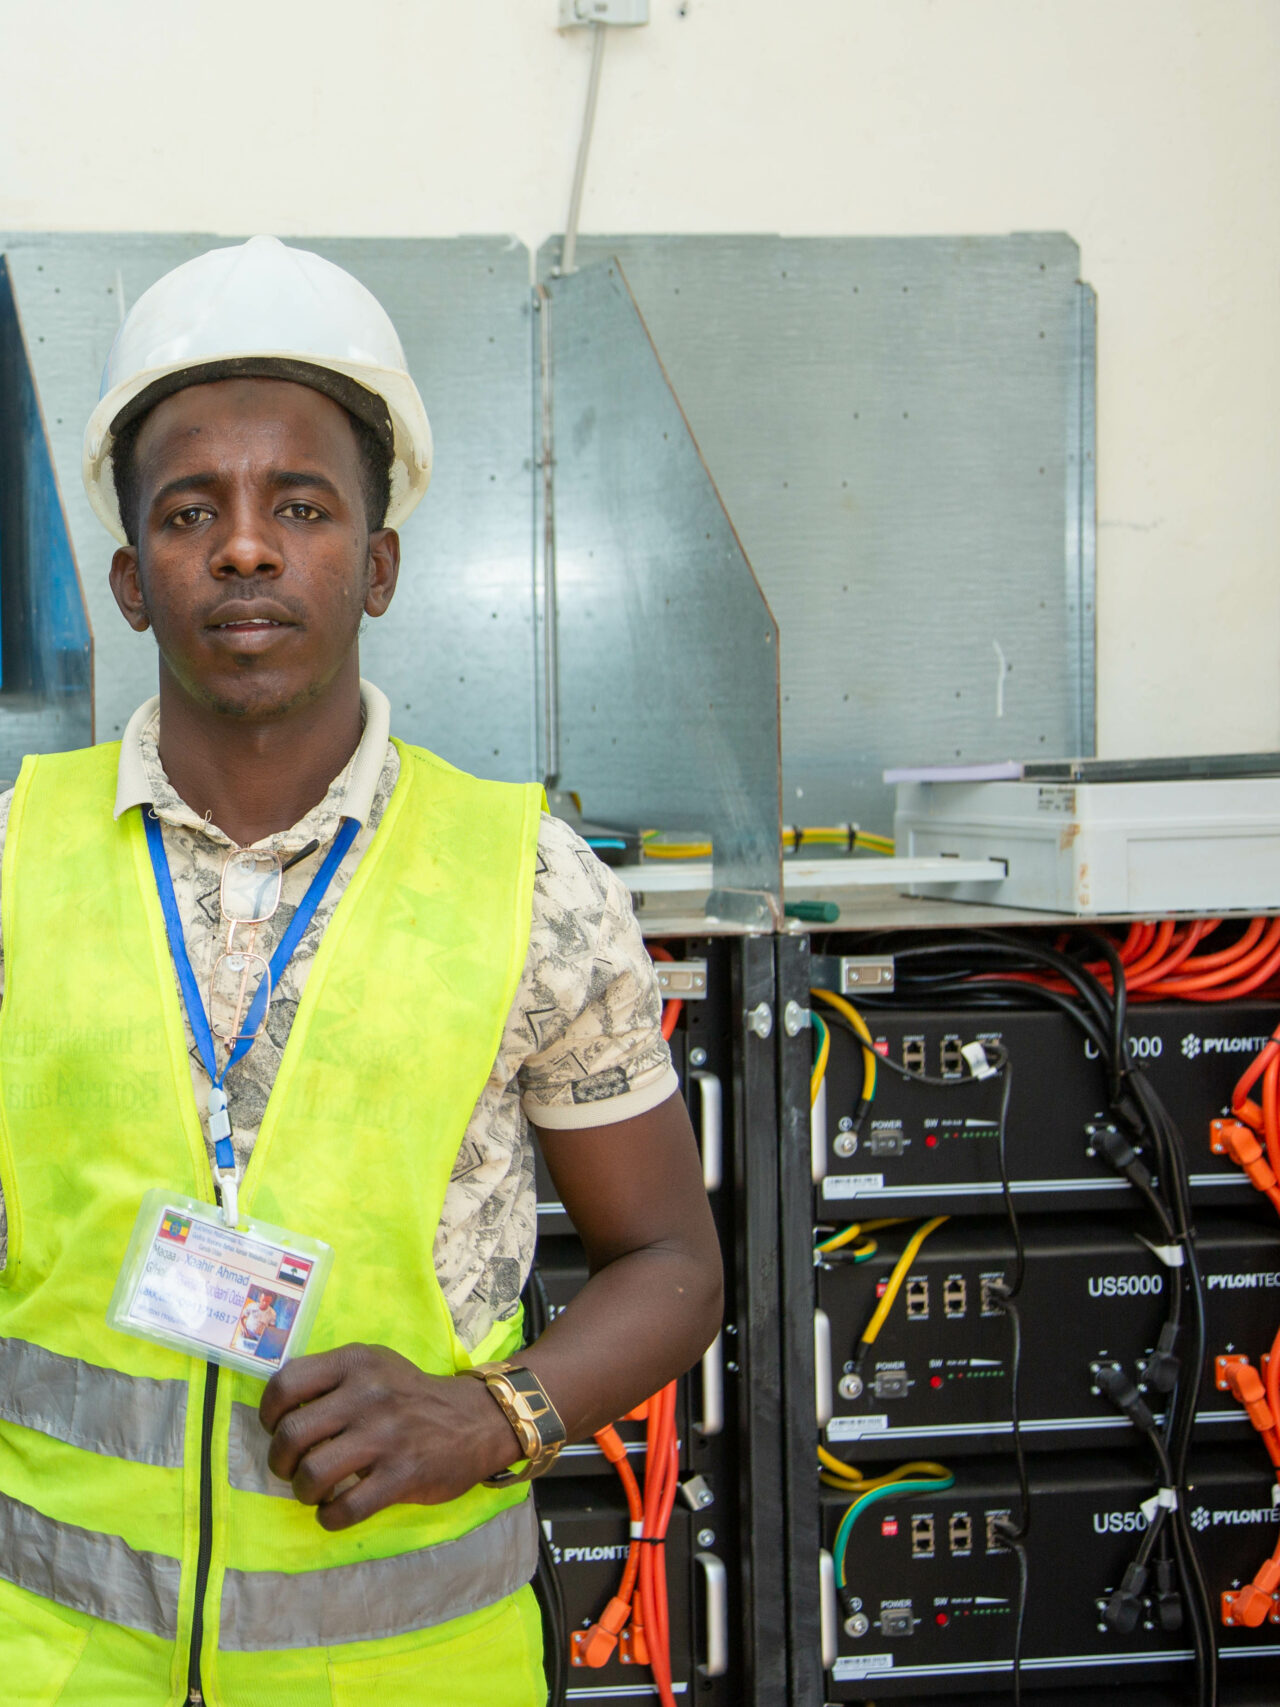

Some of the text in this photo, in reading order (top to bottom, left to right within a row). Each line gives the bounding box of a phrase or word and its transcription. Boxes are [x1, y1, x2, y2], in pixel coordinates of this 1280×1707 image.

[871, 1119, 903, 1129] POWER
[1087, 1275, 1163, 1298] US5000
[1207, 1272, 1280, 1290] PYLONTEC
[875, 1361, 906, 1371] POWER
[1093, 1511, 1148, 1534] US50
[1212, 1508, 1280, 1525] PYLONTE
[880, 1599, 912, 1609] POWER
